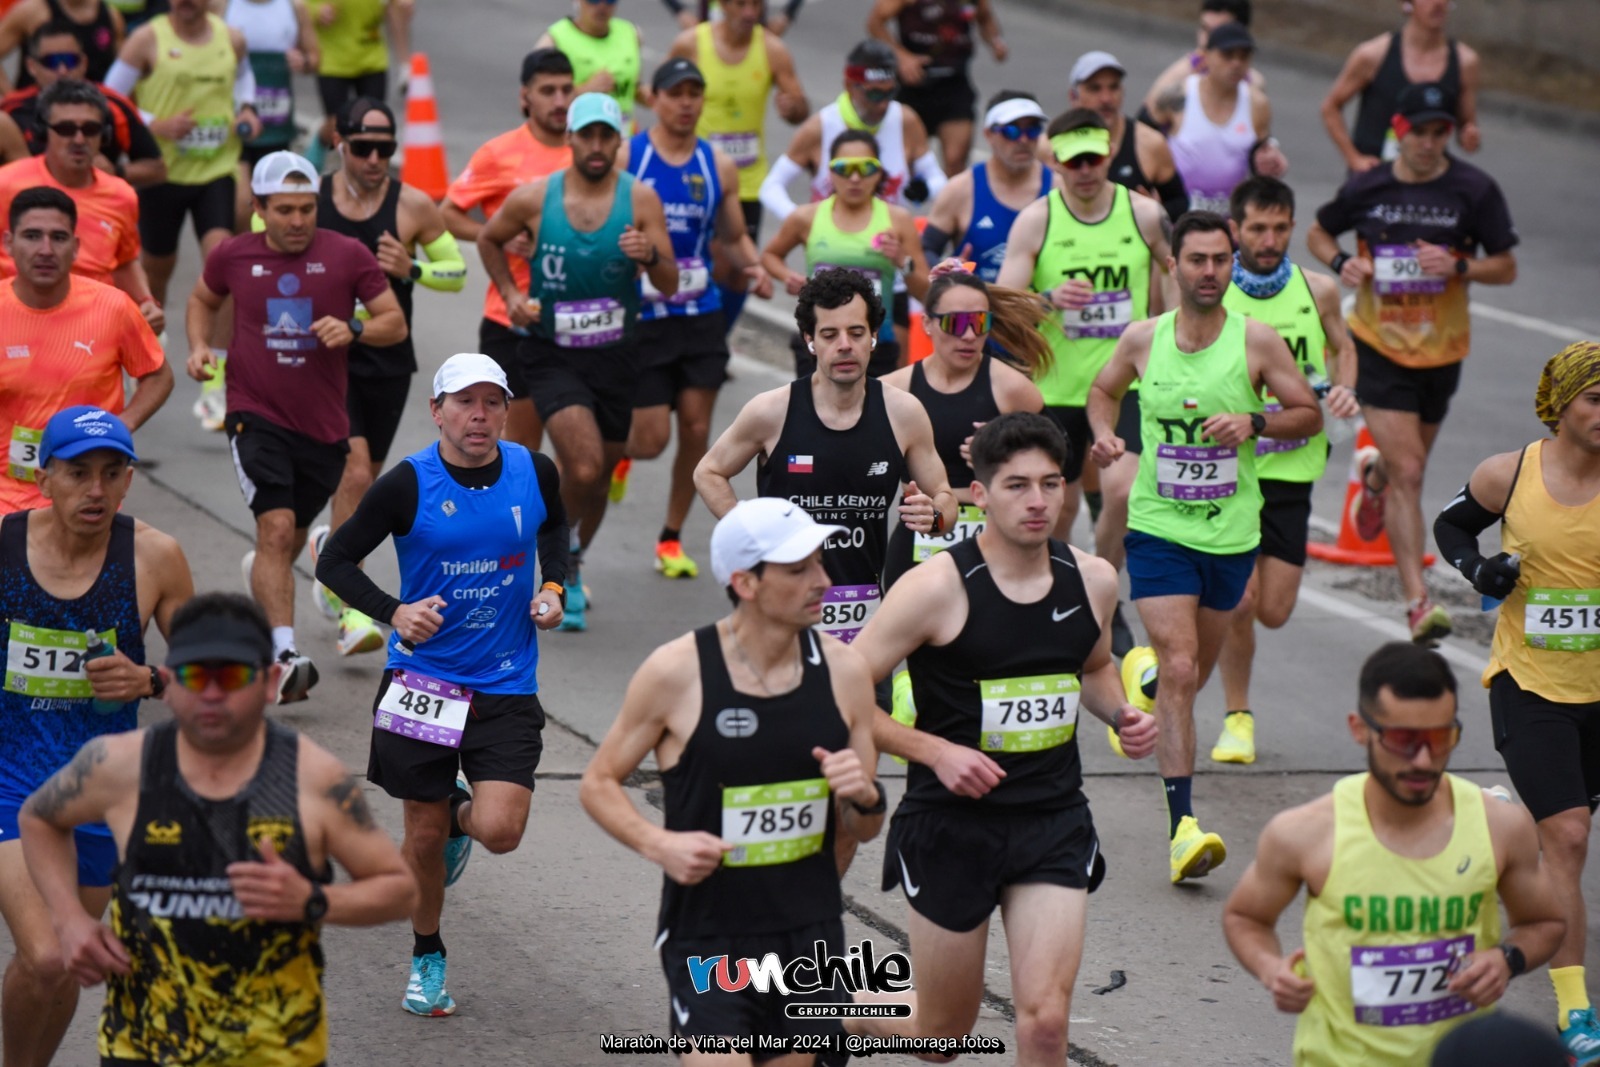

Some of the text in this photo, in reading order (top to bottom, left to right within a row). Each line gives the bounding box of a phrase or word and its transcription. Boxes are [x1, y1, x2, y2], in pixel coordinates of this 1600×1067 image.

[1393, 260, 1418, 275] 90
[1062, 265, 1129, 290] TYM
[570, 312, 613, 329] 1043
[1080, 304, 1116, 322] 641
[22, 444, 37, 462] 3
[1176, 461, 1219, 480] 792
[789, 494, 887, 508] CHILE KENYA
[856, 512, 885, 520] TEAM
[441, 559, 498, 575] Triatlón
[452, 586, 500, 601] cmpc
[822, 603, 867, 625] 850
[1540, 607, 1600, 628] 4518
[18, 629, 35, 640] 21K
[23, 646, 87, 673] 512
[398, 690, 445, 719] 481
[998, 696, 1067, 725] 7834
[741, 803, 813, 836] 7856
[1344, 893, 1484, 933] CRONOS
[1384, 965, 1448, 998] 772
